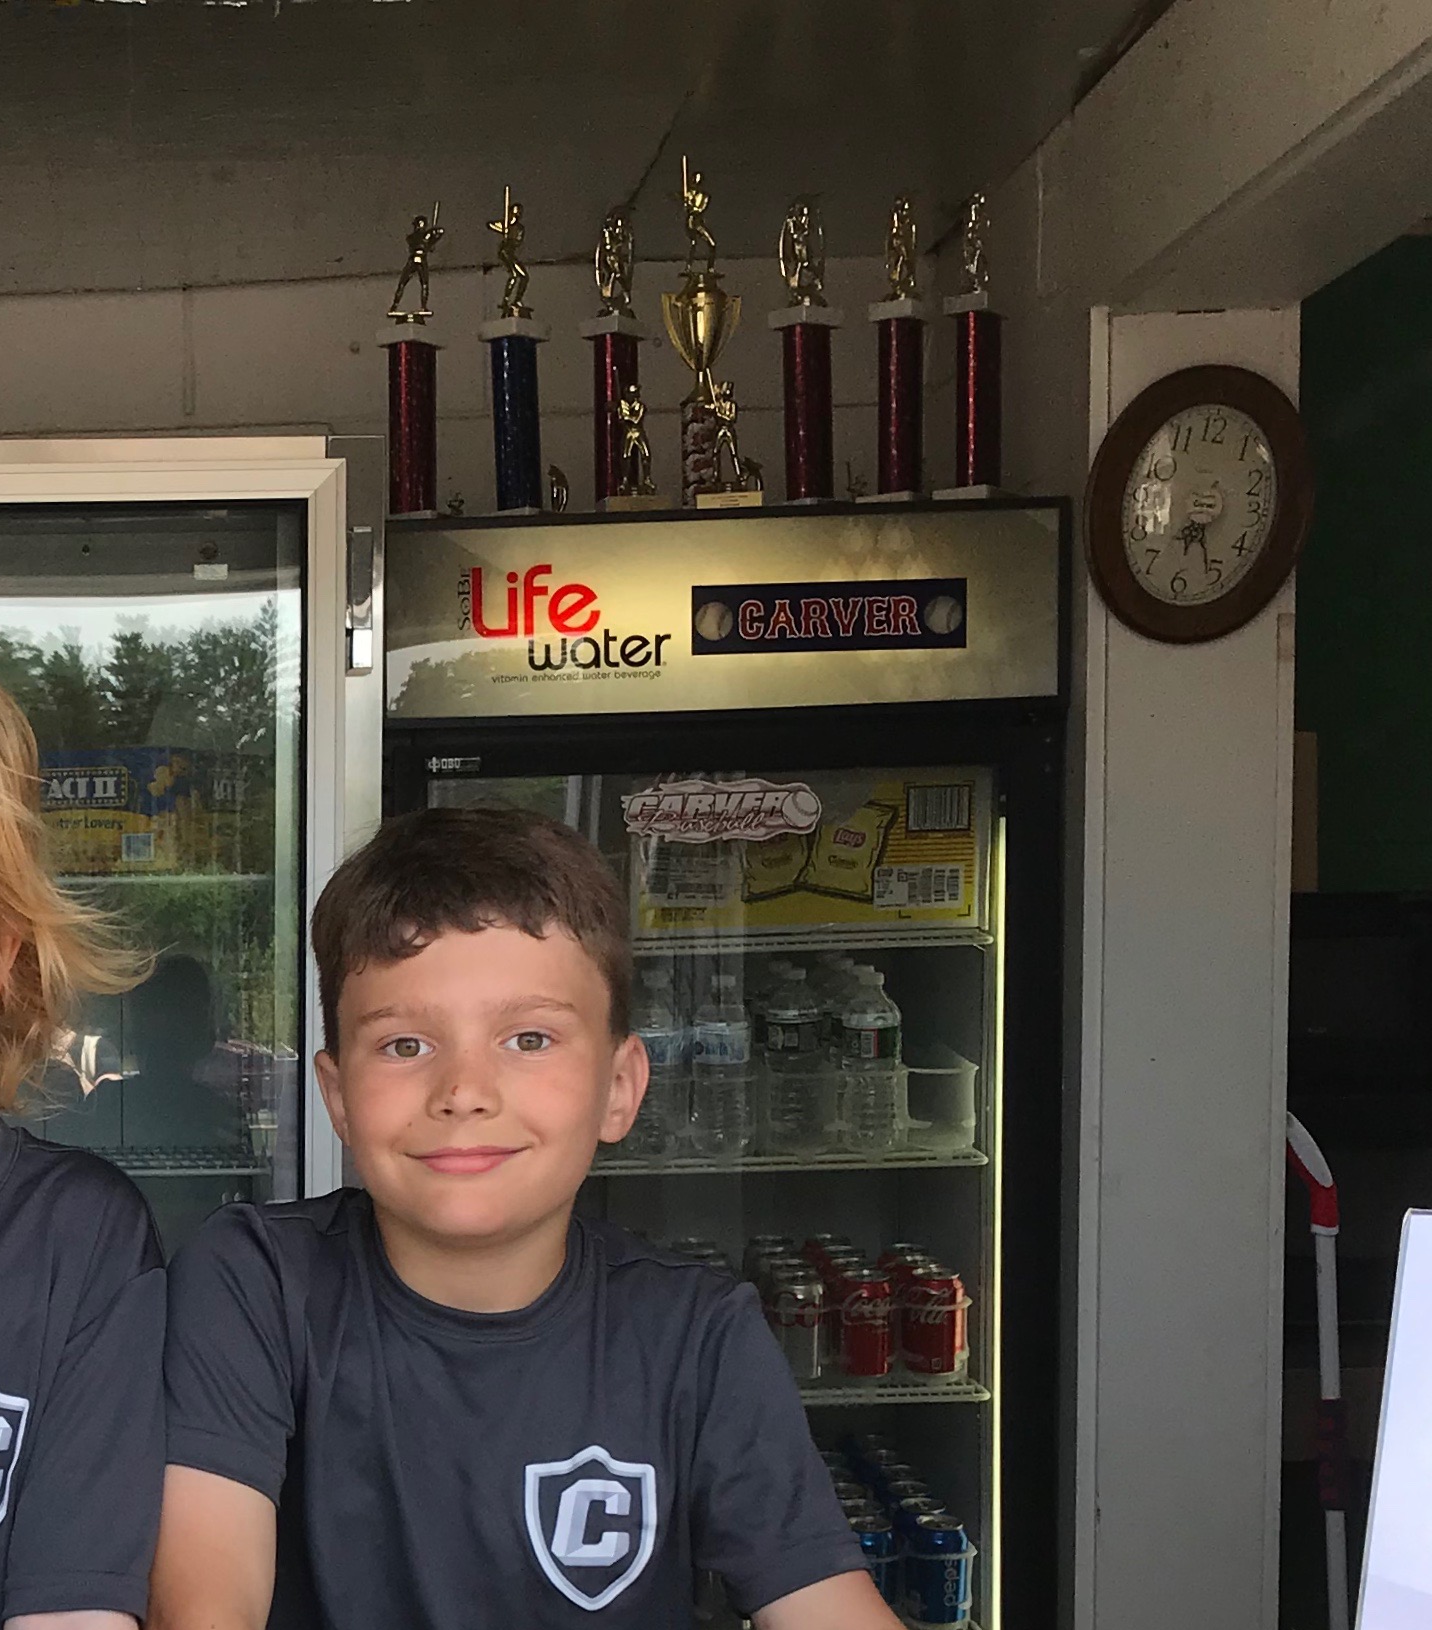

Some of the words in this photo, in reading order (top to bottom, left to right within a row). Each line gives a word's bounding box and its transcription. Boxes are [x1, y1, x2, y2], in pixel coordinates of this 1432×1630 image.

[1171, 425, 1192, 454] 11
[1201, 416, 1228, 444] 12
[1238, 433, 1250, 461] 1
[1146, 453, 1177, 481] 10
[1245, 469, 1263, 497] 2
[1243, 501, 1261, 528] 3
[1231, 530, 1253, 557] 4
[1145, 549, 1161, 575] 7
[1206, 560, 1223, 585] 5
[1170, 569, 1188, 593] 6
[472, 564, 601, 638] Life
[738, 596, 921, 640] CARVER
[528, 629, 671, 671] water
[492, 672, 529, 683] vitamin
[532, 671, 579, 682] enhanced
[582, 671, 610, 681] water
[614, 670, 661, 683] beverage
[47, 777, 88, 799] ACT
[626, 791, 790, 821] CARVER
[638, 810, 765, 833] Baseball
[551, 1479, 631, 1566] C
